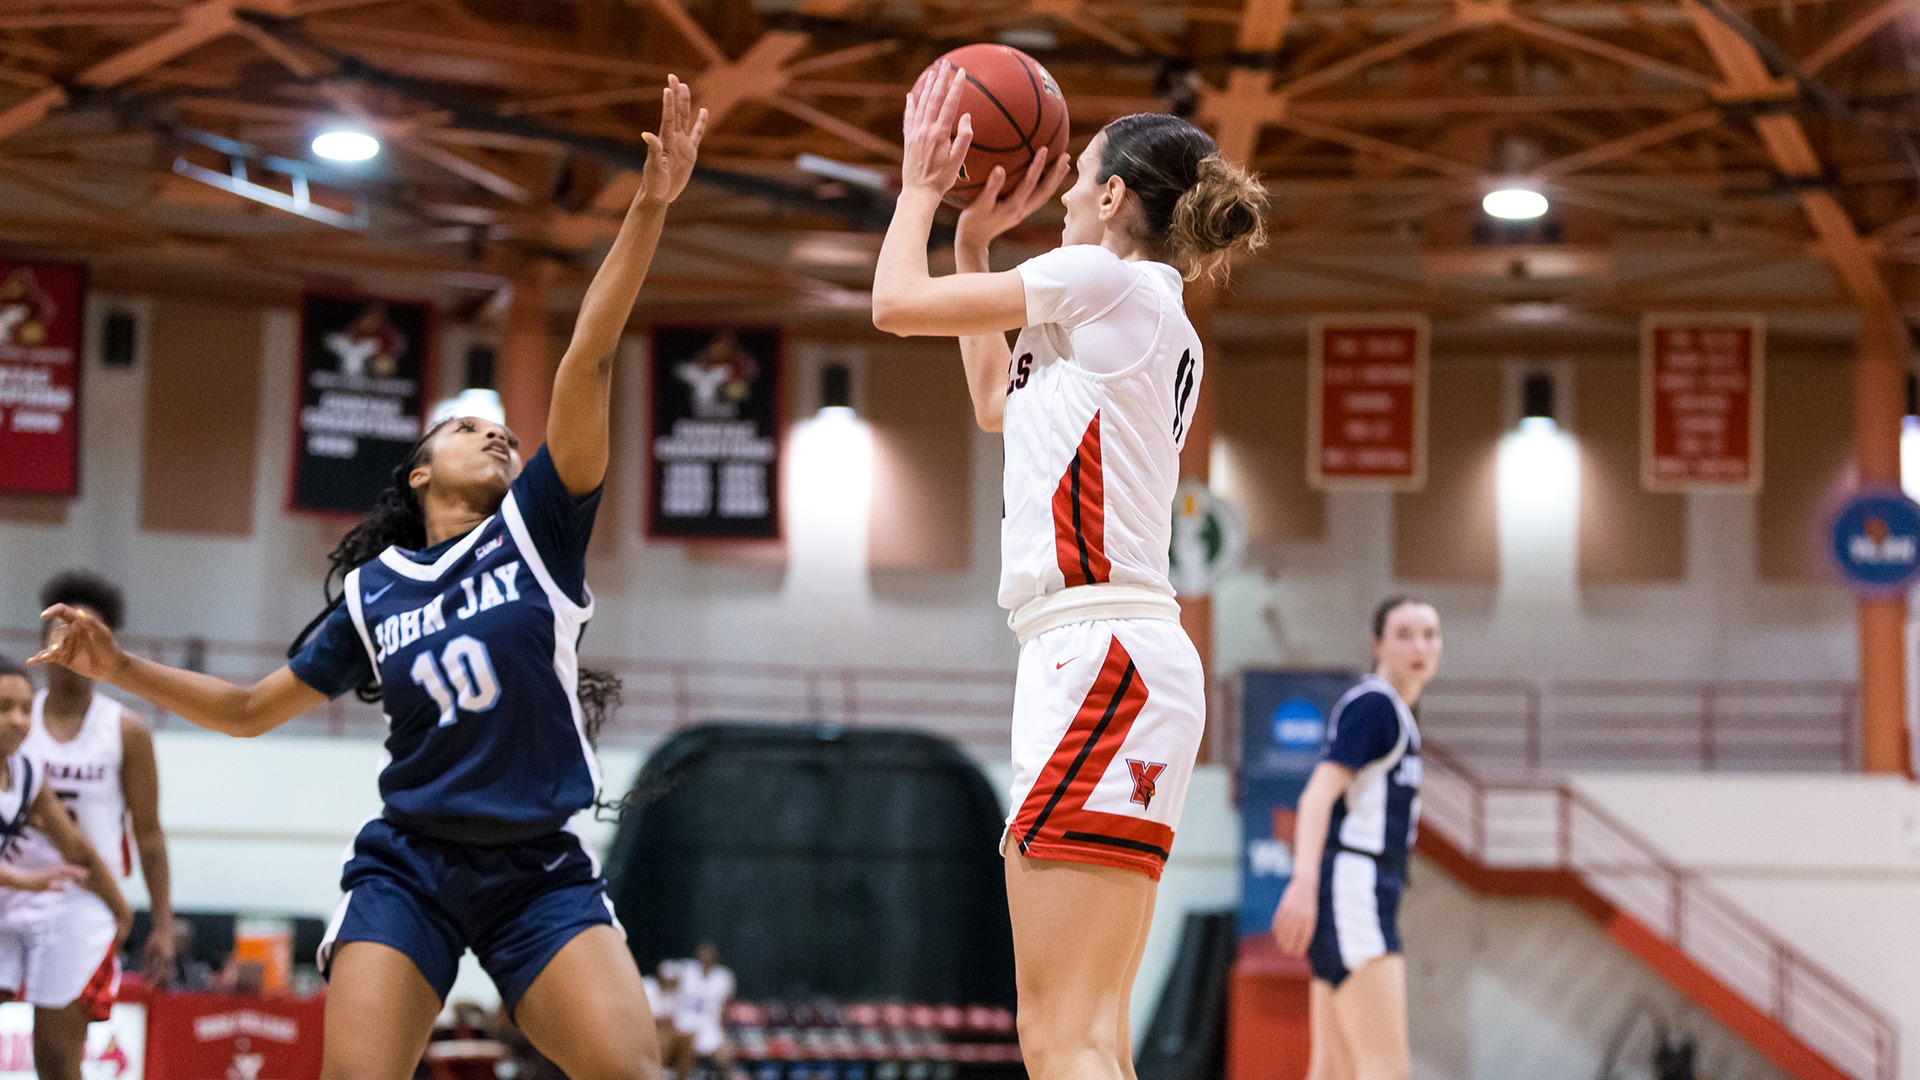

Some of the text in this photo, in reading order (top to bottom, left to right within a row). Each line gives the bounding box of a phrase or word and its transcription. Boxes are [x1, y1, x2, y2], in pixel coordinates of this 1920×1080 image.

[374, 561, 521, 664] JOHN JAY
[410, 633, 502, 728] 10
[1126, 758, 1168, 811] Y
